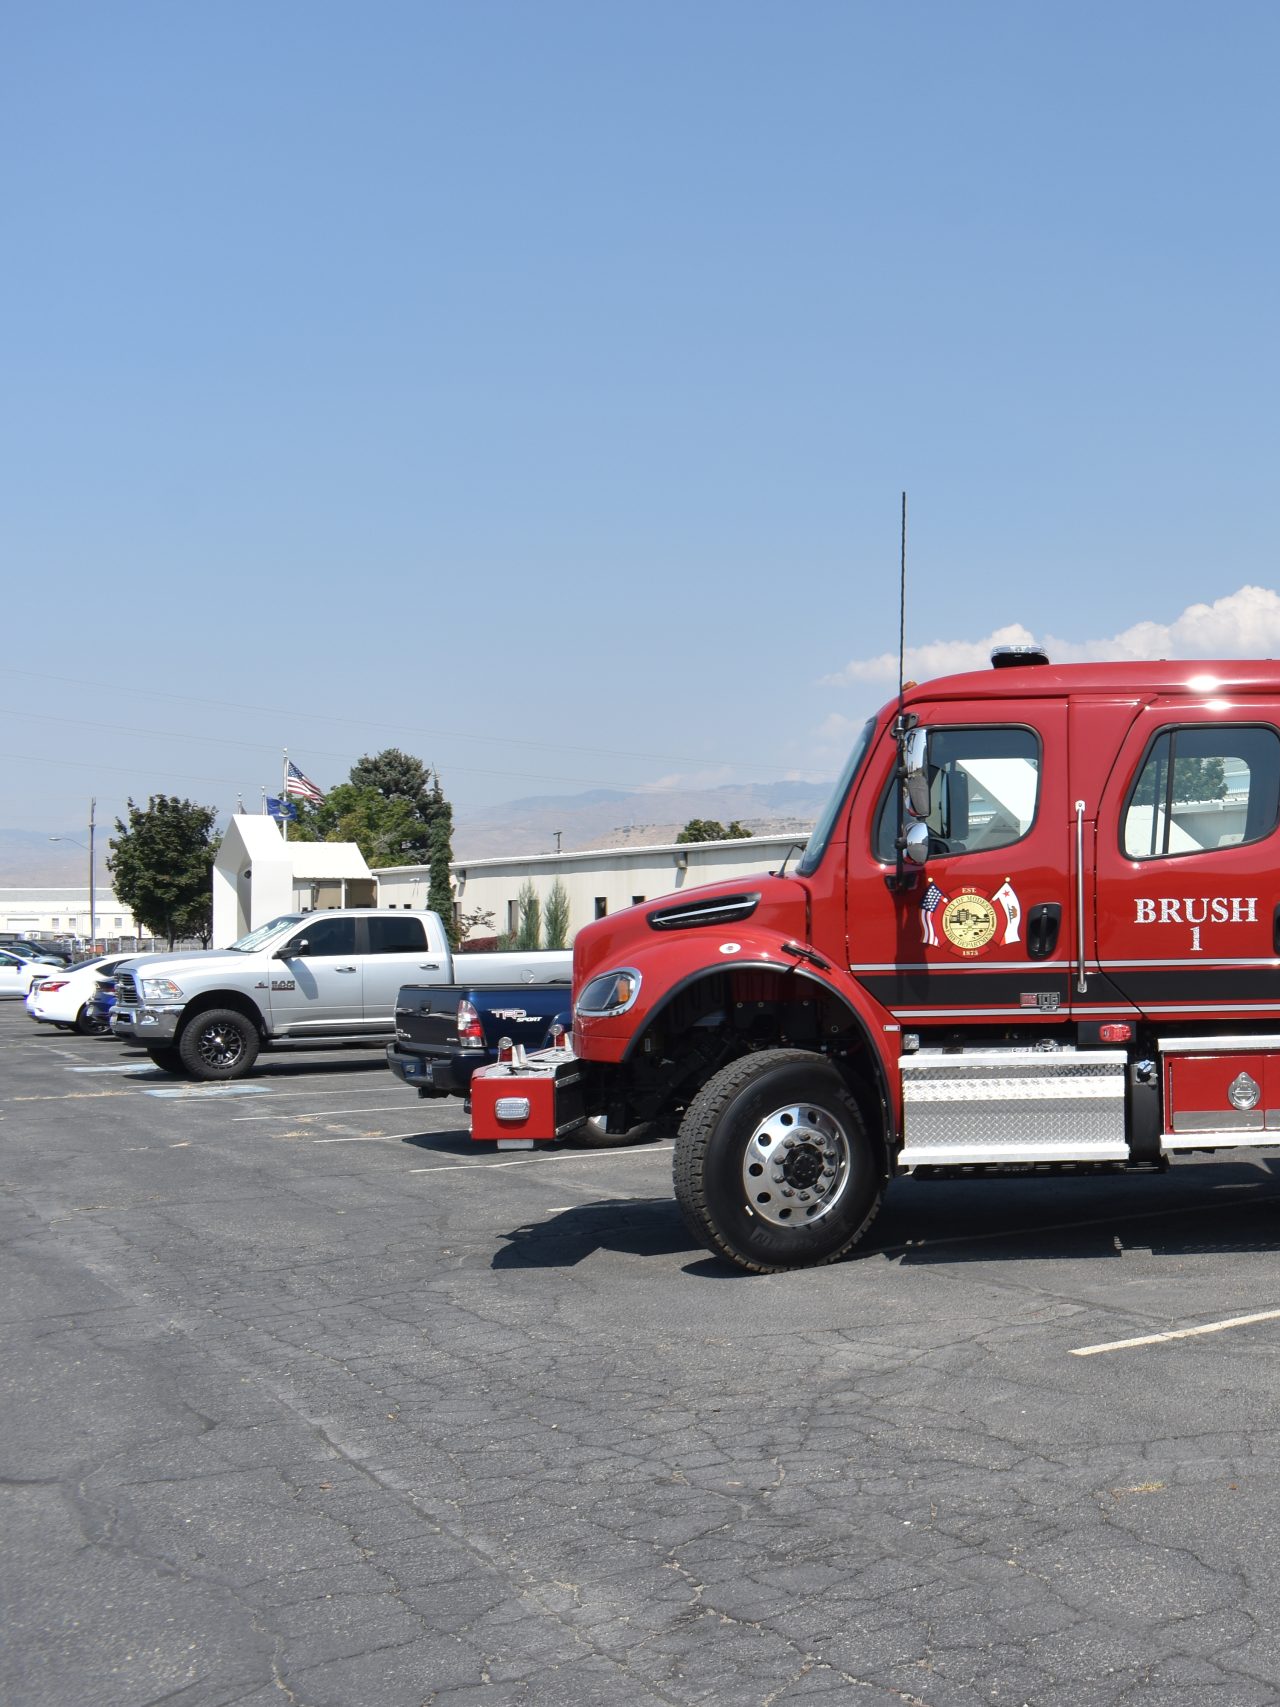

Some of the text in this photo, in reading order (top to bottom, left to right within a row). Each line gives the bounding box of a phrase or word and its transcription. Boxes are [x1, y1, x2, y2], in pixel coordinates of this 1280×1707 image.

[945, 895, 994, 917] CITY OF MODESTO
[1133, 897, 1258, 923] BRUSH
[957, 929, 994, 948] DEPARTMENT
[1190, 926, 1203, 951] 1
[491, 1009, 527, 1020] TRD
